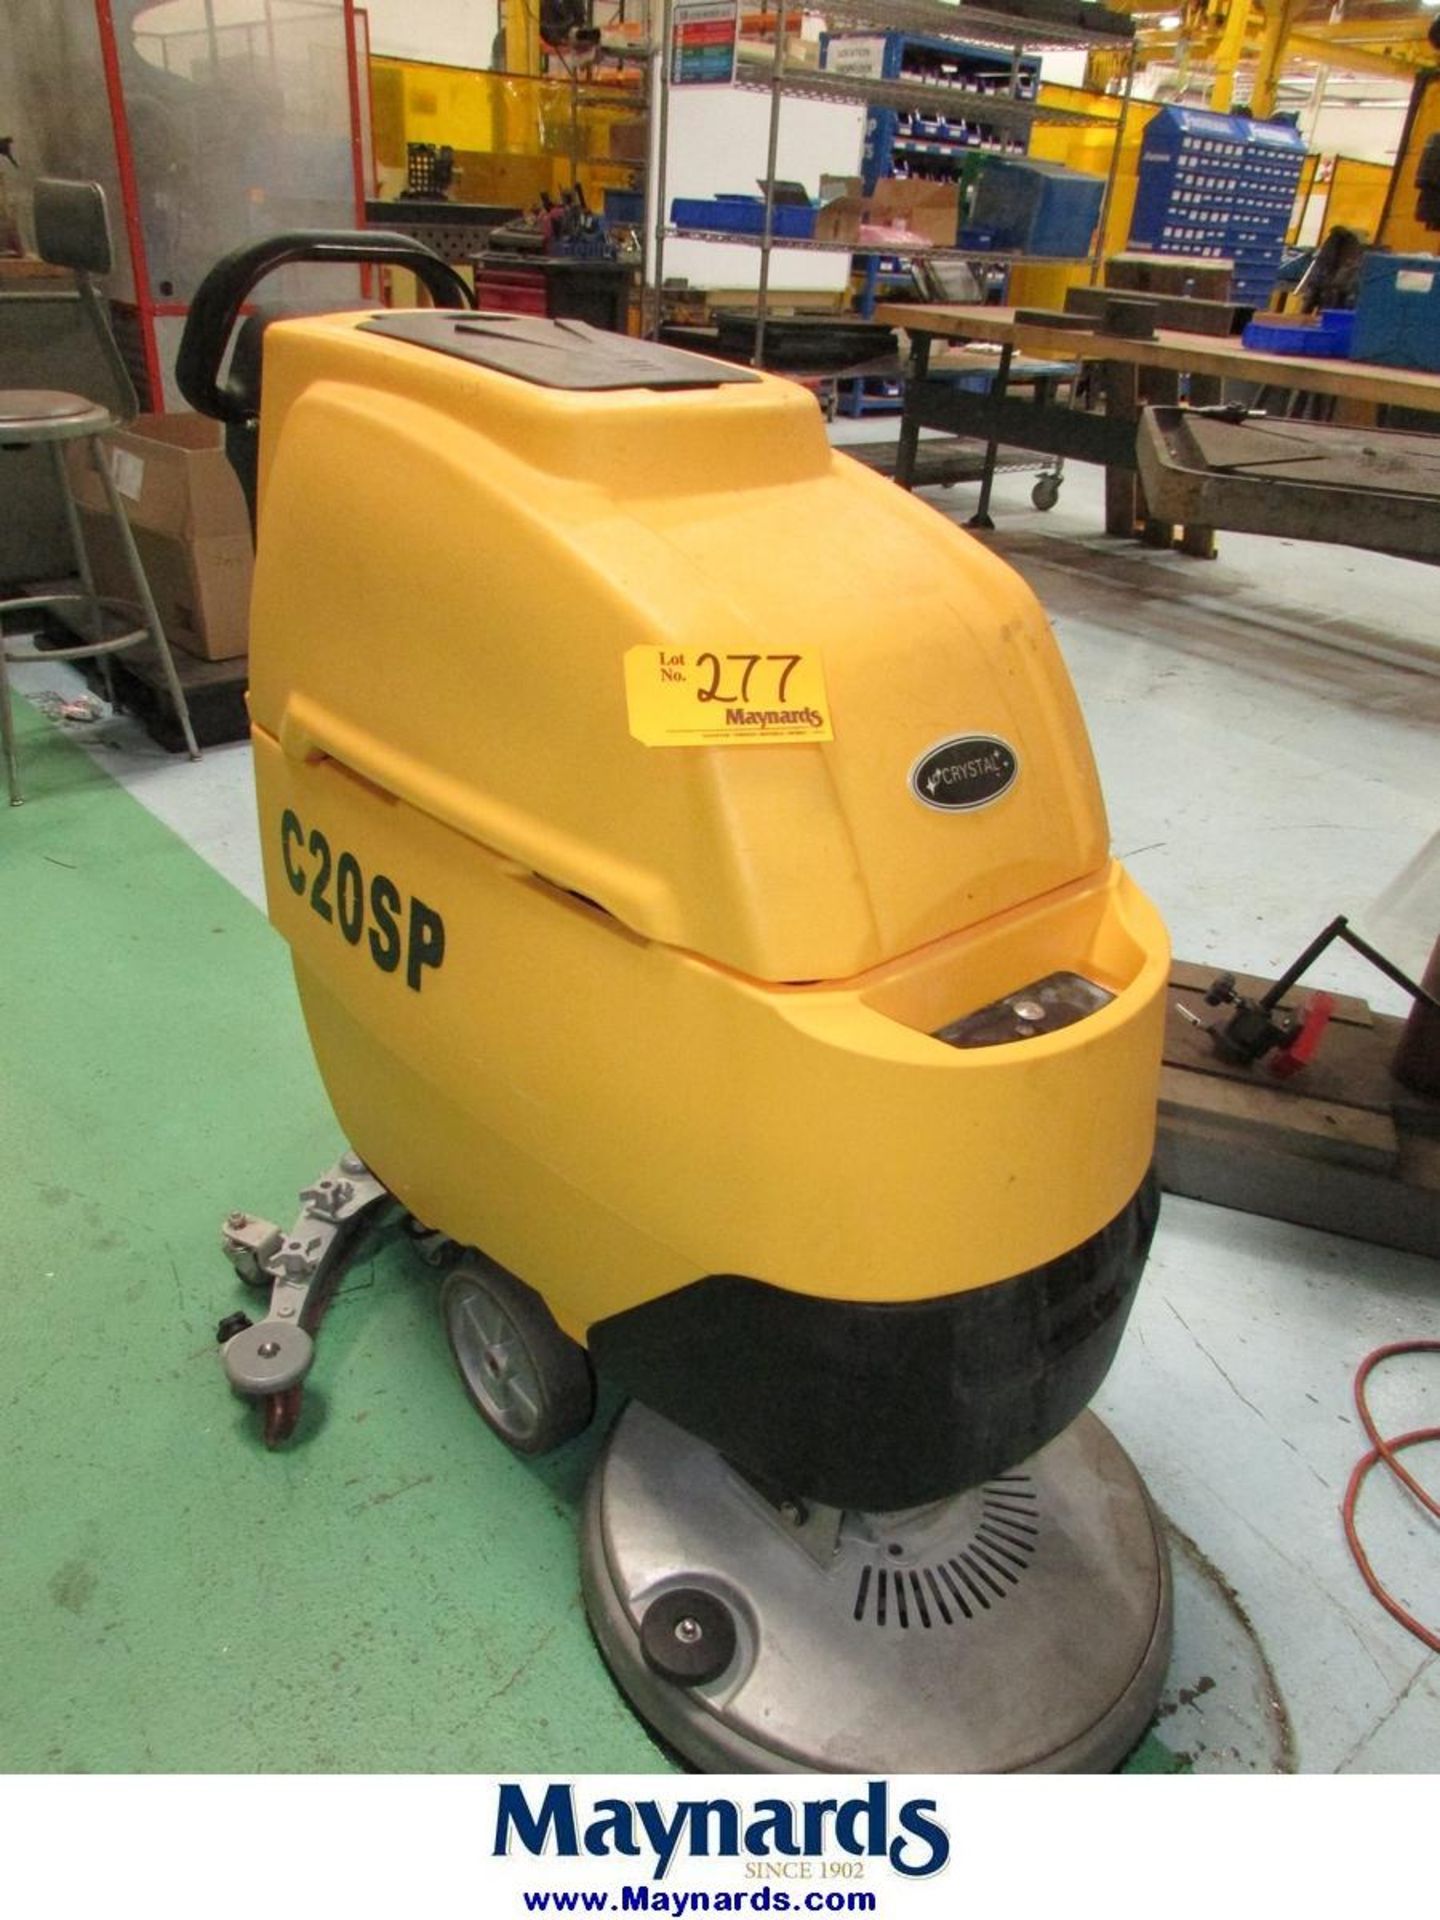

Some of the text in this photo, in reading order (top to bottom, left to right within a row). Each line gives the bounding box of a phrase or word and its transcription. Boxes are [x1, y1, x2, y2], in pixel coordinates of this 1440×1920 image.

[659, 652, 685, 666] Lot
[661, 668, 687, 682] No.
[696, 652, 802, 703] 277
[726, 707, 823, 729] Maynards
[941, 757, 1001, 785] CRYSTAL
[281, 809, 445, 992] C20SP
